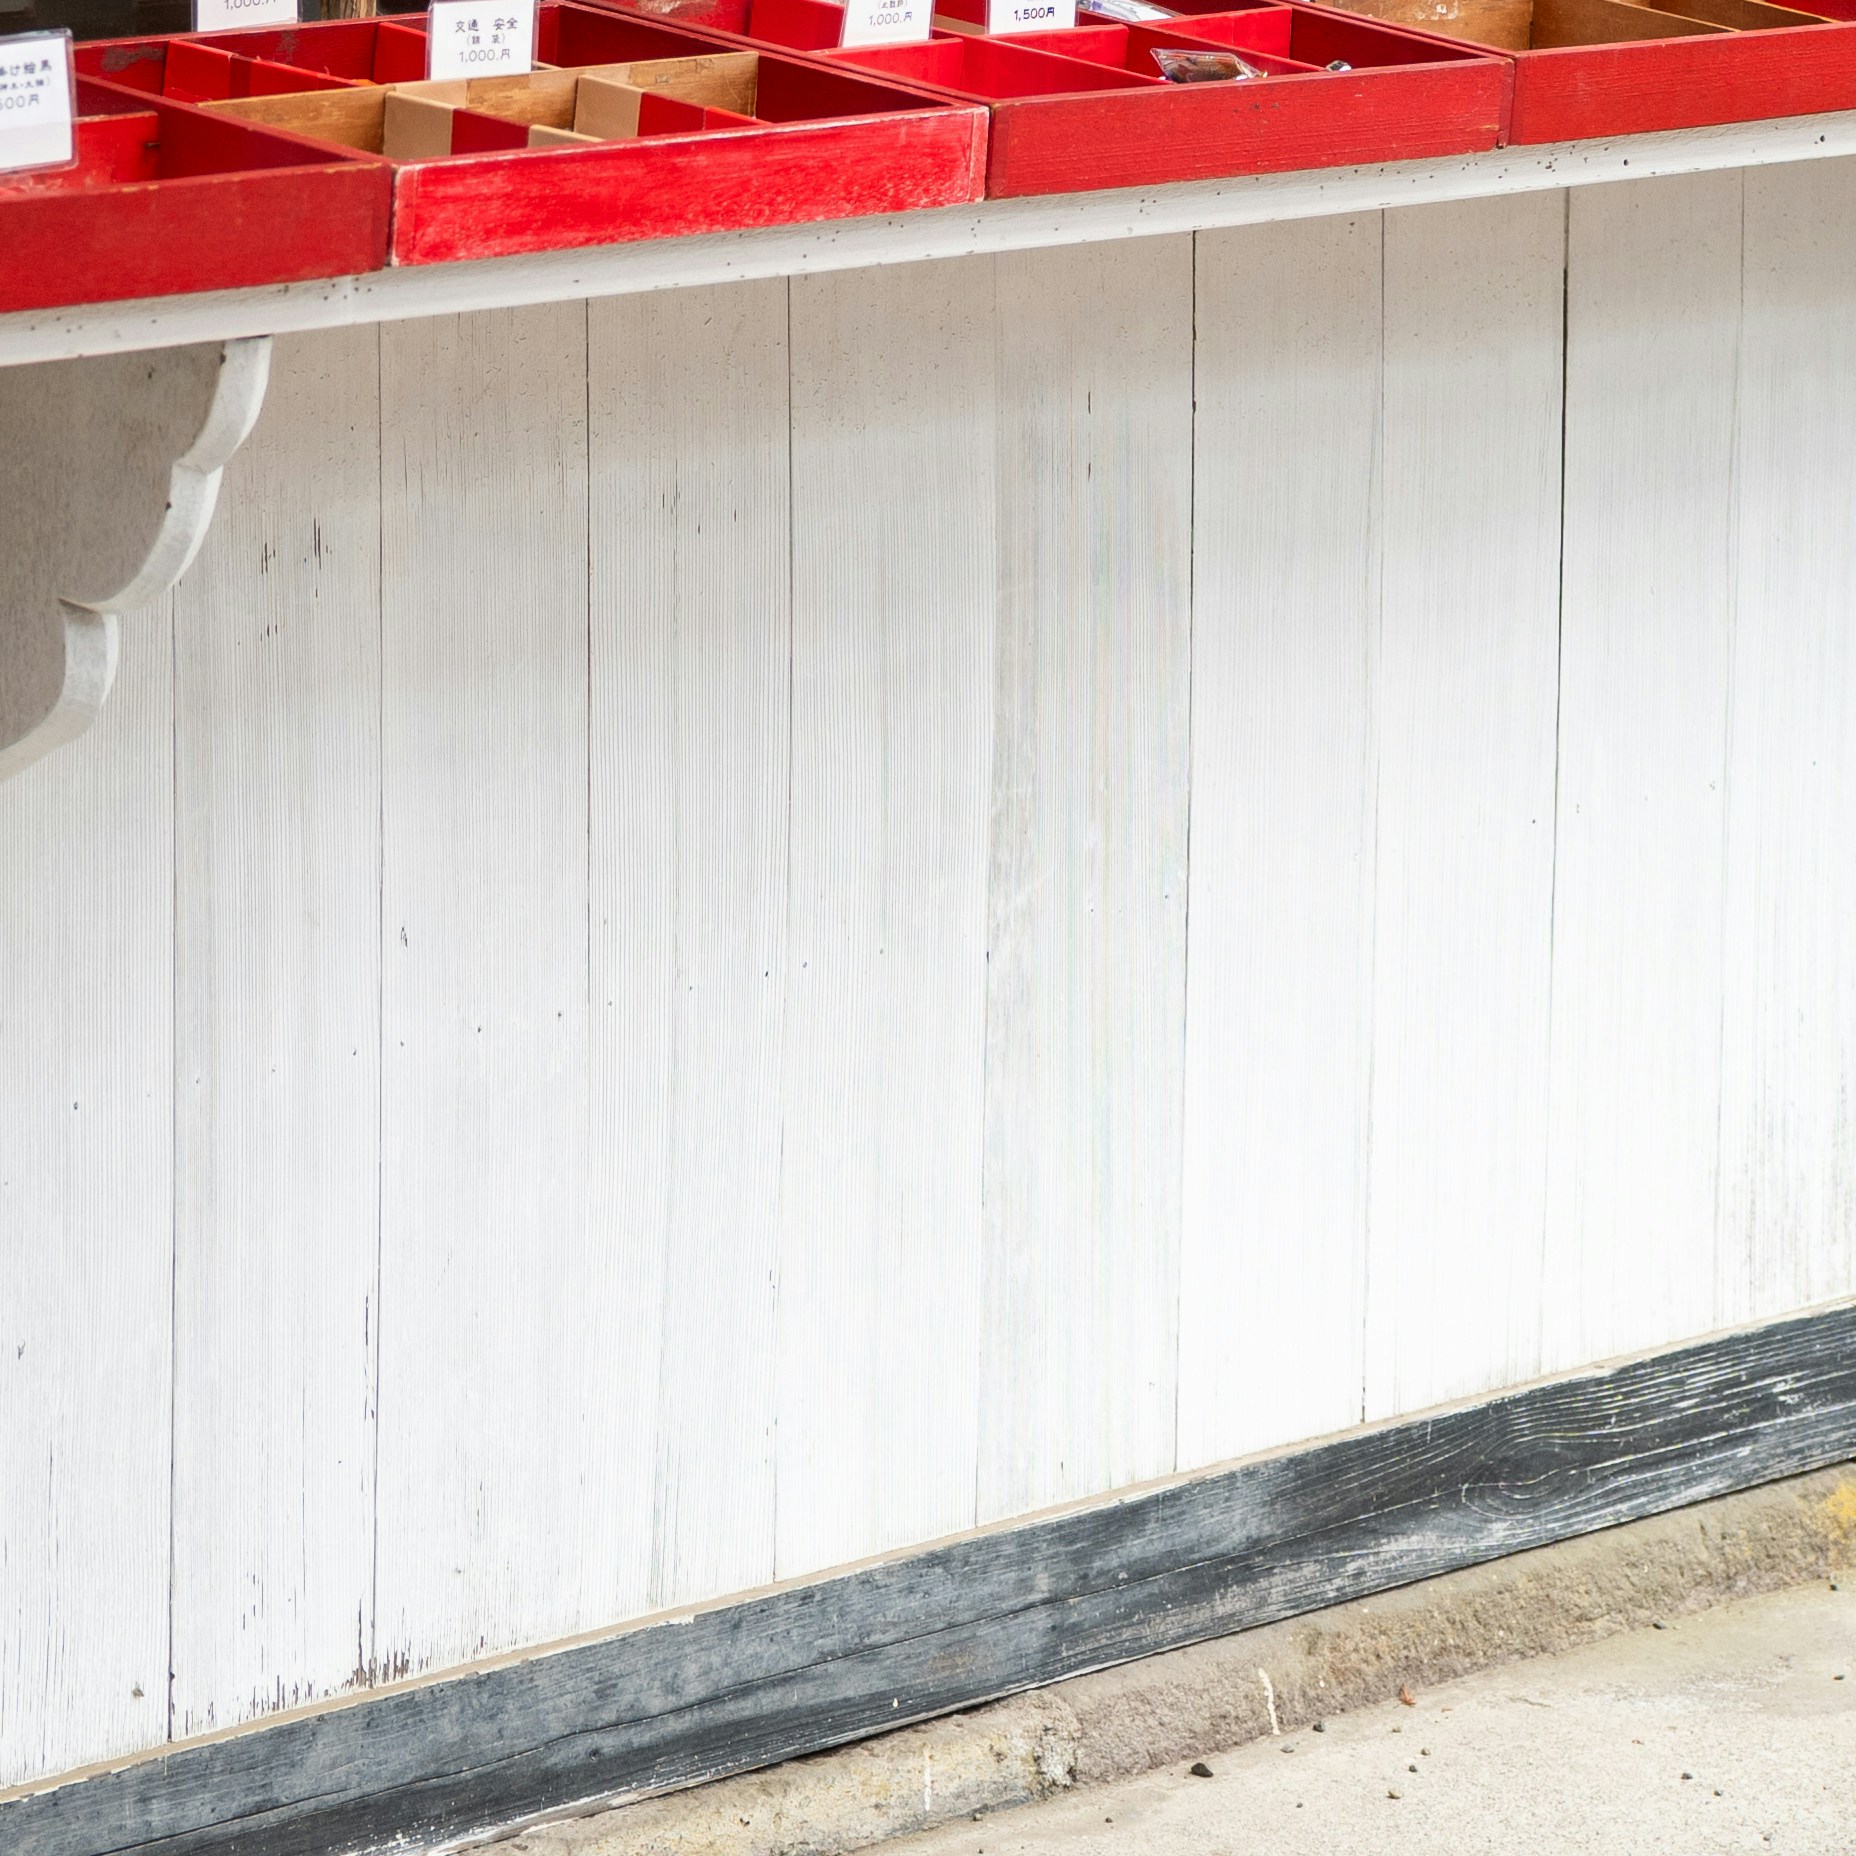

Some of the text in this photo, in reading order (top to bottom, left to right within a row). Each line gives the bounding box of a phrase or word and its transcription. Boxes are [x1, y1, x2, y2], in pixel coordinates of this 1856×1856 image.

[1013, 6, 1055, 22] 1,500円
[455, 17, 518, 33] 交通 安全
